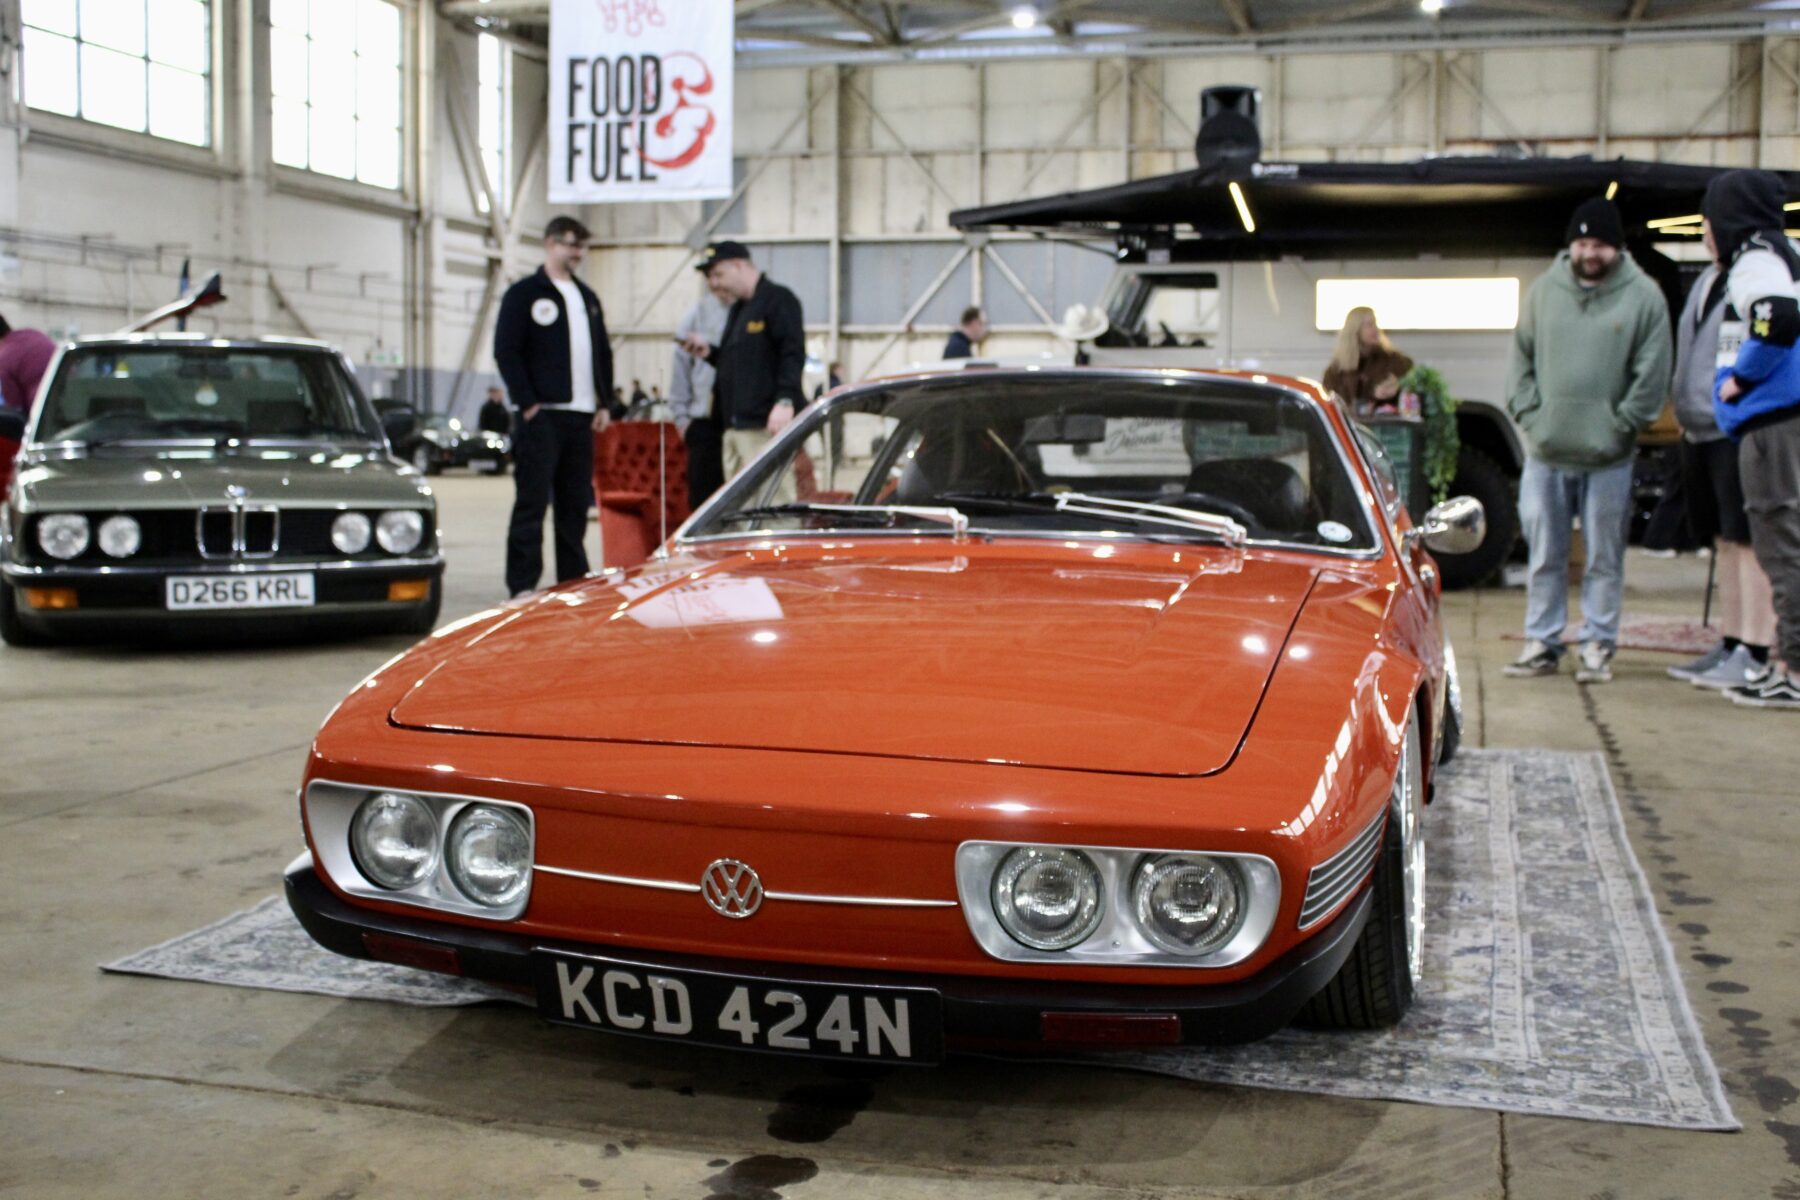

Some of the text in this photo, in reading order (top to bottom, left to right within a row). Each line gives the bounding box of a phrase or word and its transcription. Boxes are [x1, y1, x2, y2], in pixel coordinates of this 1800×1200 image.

[567, 54, 662, 118] FOOD
[567, 120, 658, 183] FUEL
[173, 578, 309, 604] D266 KRL
[702, 858, 763, 917] VW
[556, 961, 911, 1057] KCD 424N
